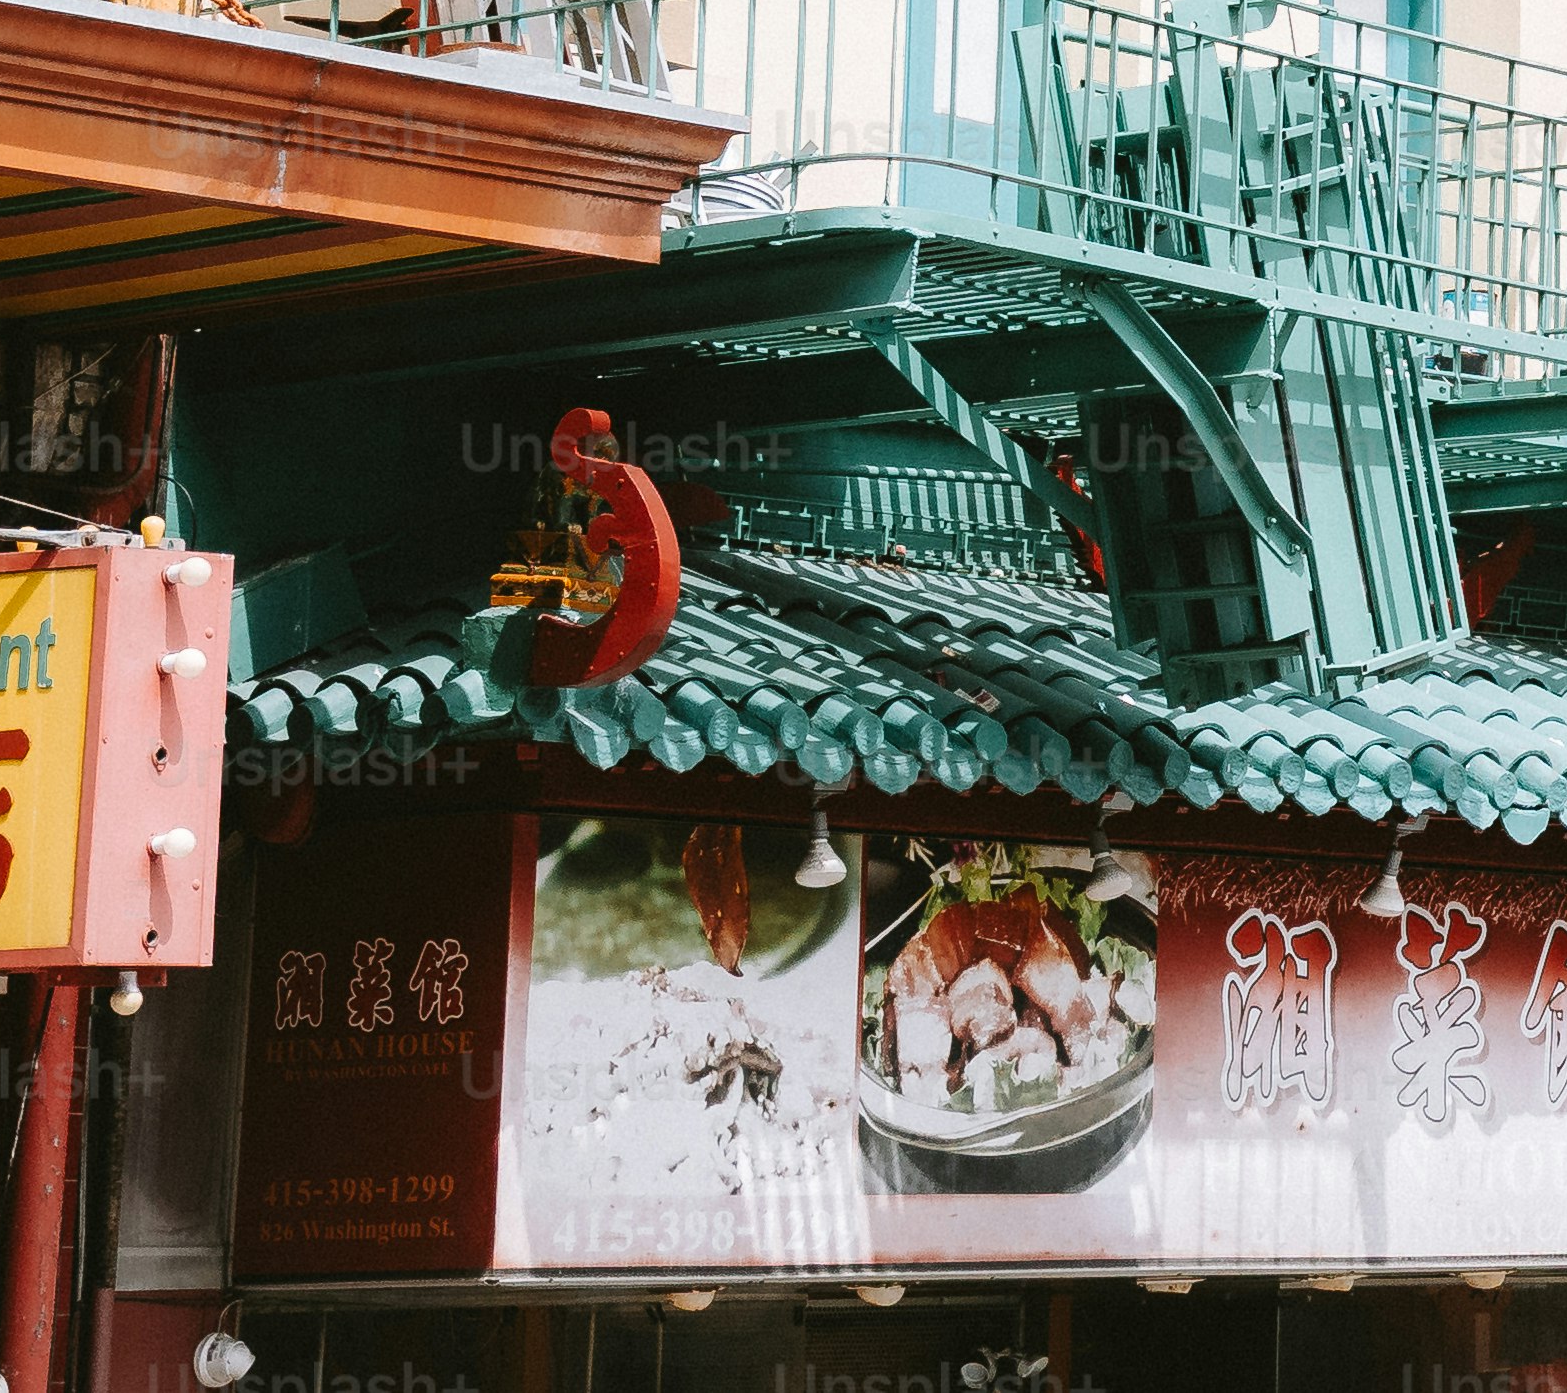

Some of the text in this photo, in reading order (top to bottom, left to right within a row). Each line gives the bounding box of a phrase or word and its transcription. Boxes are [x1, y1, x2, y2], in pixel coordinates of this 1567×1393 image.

[265, 1029, 475, 1065] HUNAN HOUSE
[264, 1174, 456, 1207] 415-398-1299
[259, 1216, 455, 1245] 826 Washington St.
